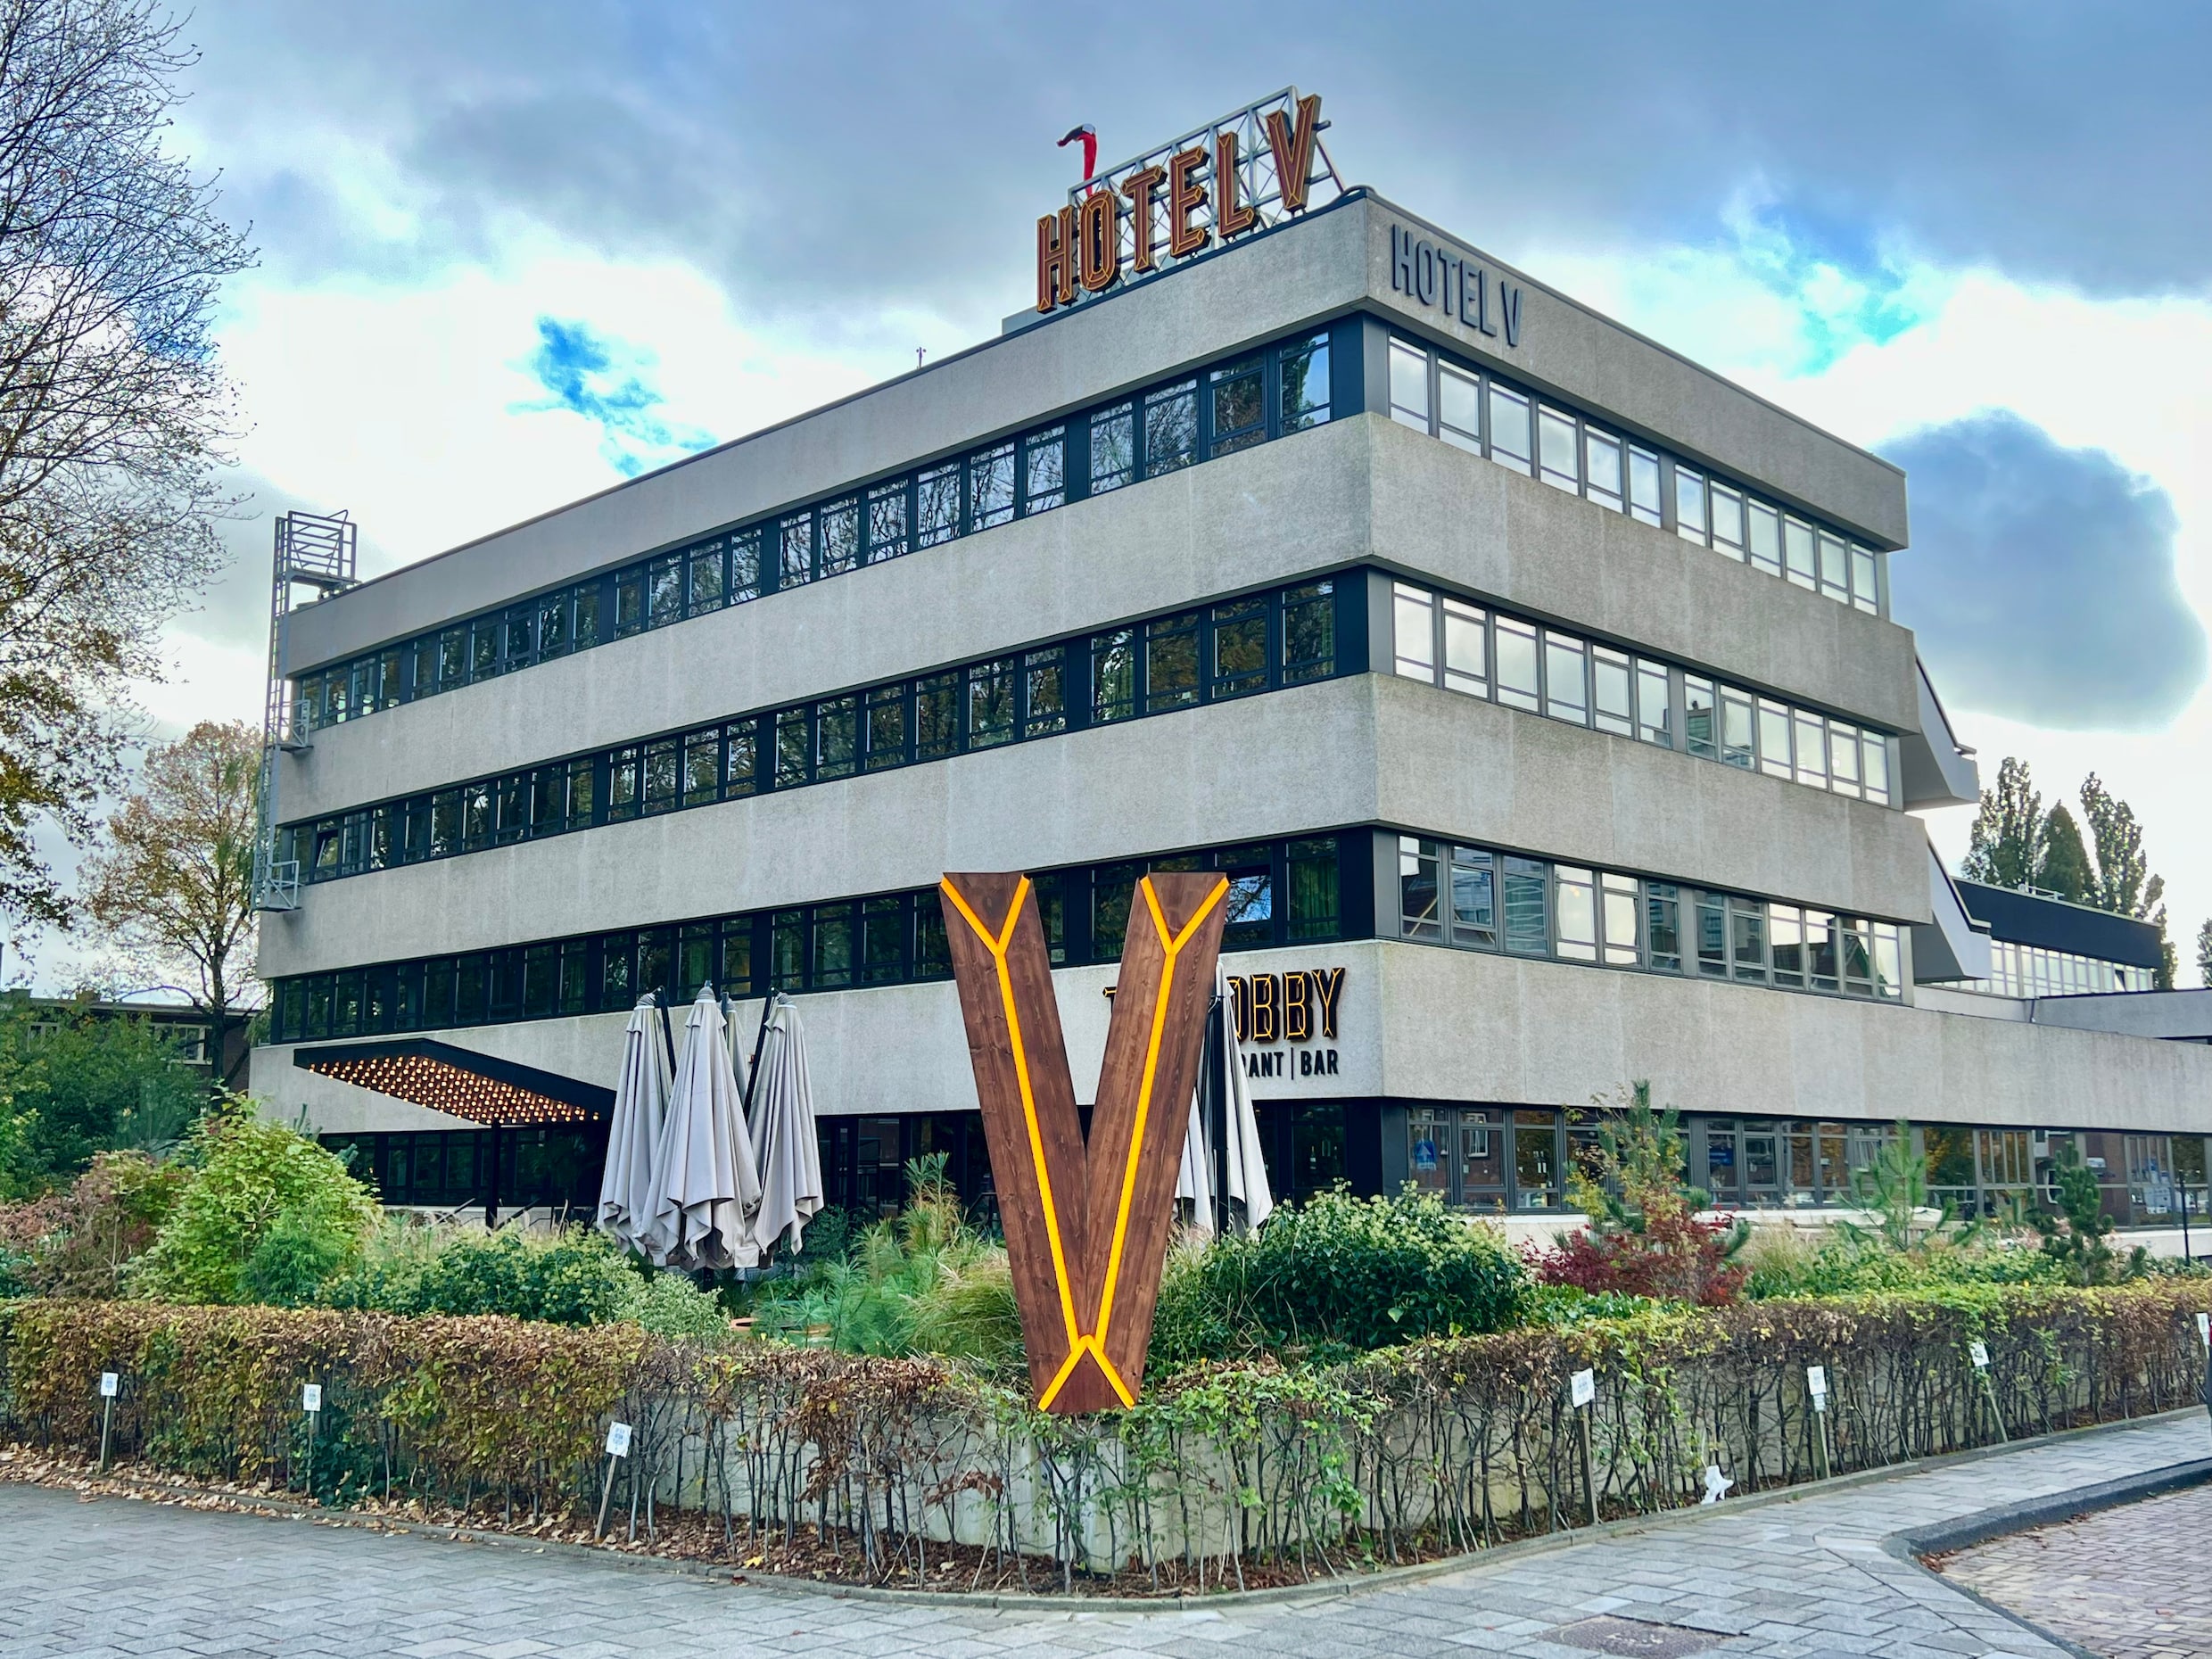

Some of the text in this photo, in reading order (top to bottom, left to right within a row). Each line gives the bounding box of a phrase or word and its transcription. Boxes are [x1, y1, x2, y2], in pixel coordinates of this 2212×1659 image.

[1036, 94, 1321, 314] HOTEL V
[1391, 224, 1523, 347] HOTEL V
[1226, 967, 1345, 1043] OBBY
[1300, 1049, 1339, 1076] BAR
[939, 872, 1229, 1413] V
